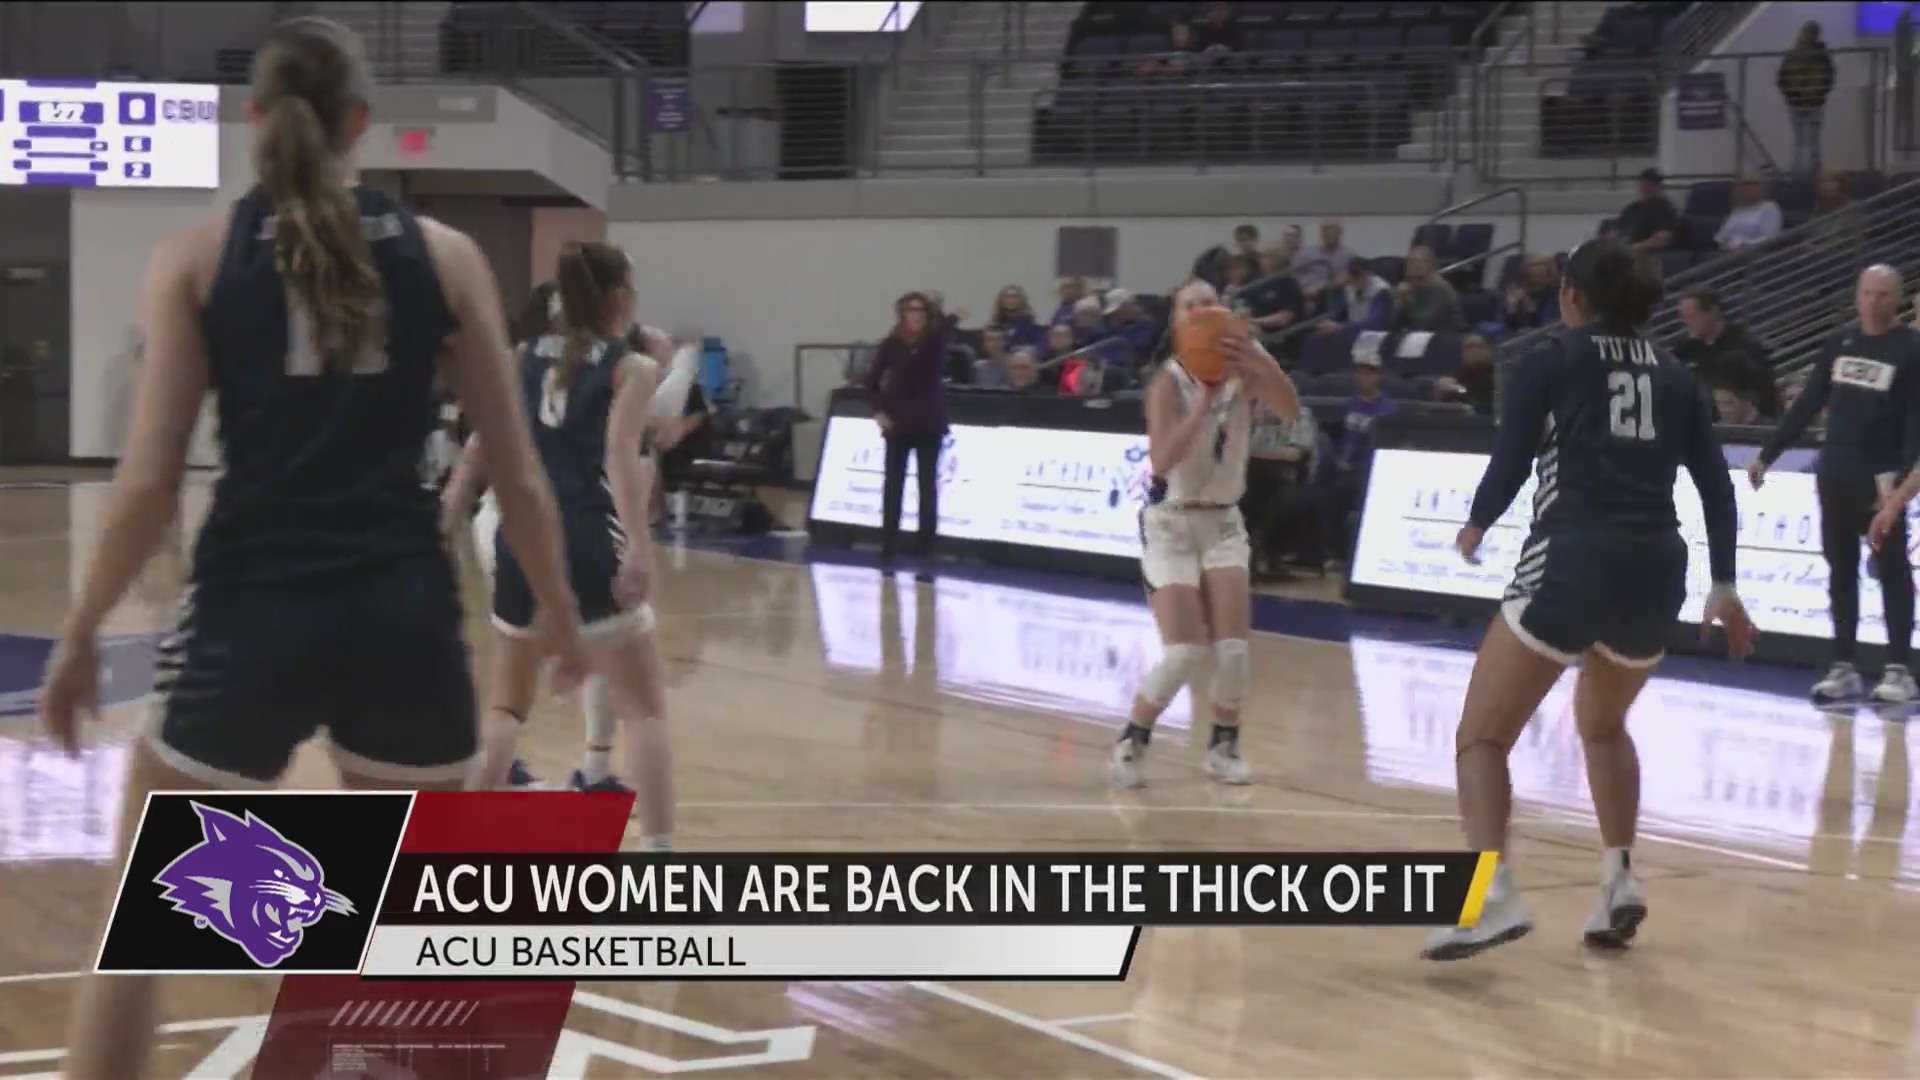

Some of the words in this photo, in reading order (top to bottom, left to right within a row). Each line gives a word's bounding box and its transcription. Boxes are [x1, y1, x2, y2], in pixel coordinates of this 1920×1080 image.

[128, 98, 147, 120] 0
[162, 98, 217, 123] CBU
[1607, 370, 1656, 439] 21
